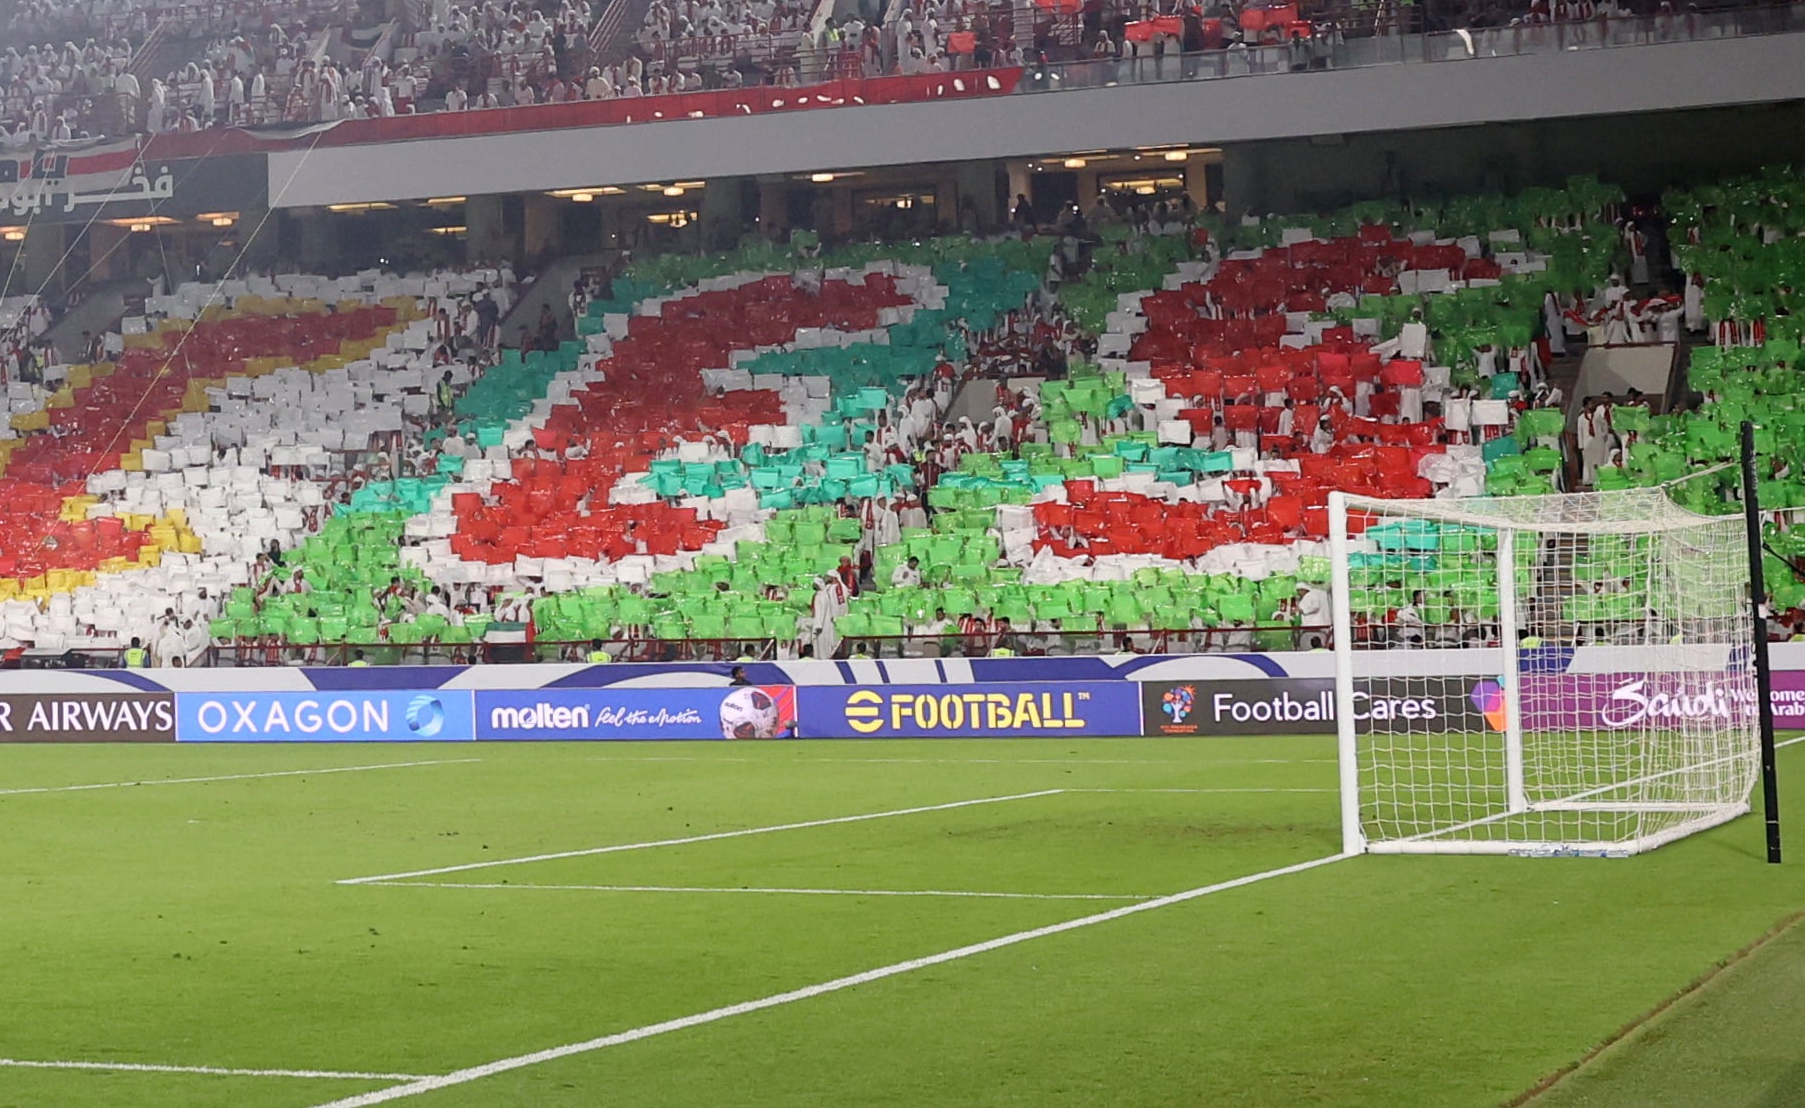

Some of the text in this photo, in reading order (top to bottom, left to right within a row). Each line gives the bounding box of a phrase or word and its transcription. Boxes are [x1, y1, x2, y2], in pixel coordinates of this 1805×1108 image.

[27, 700, 173, 732] AIRWAYS
[197, 698, 388, 734] OXAGON
[491, 702, 590, 730] molten
[594, 706, 626, 728] feel
[624, 709, 648, 725] the
[1213, 691, 1334, 722] Football
